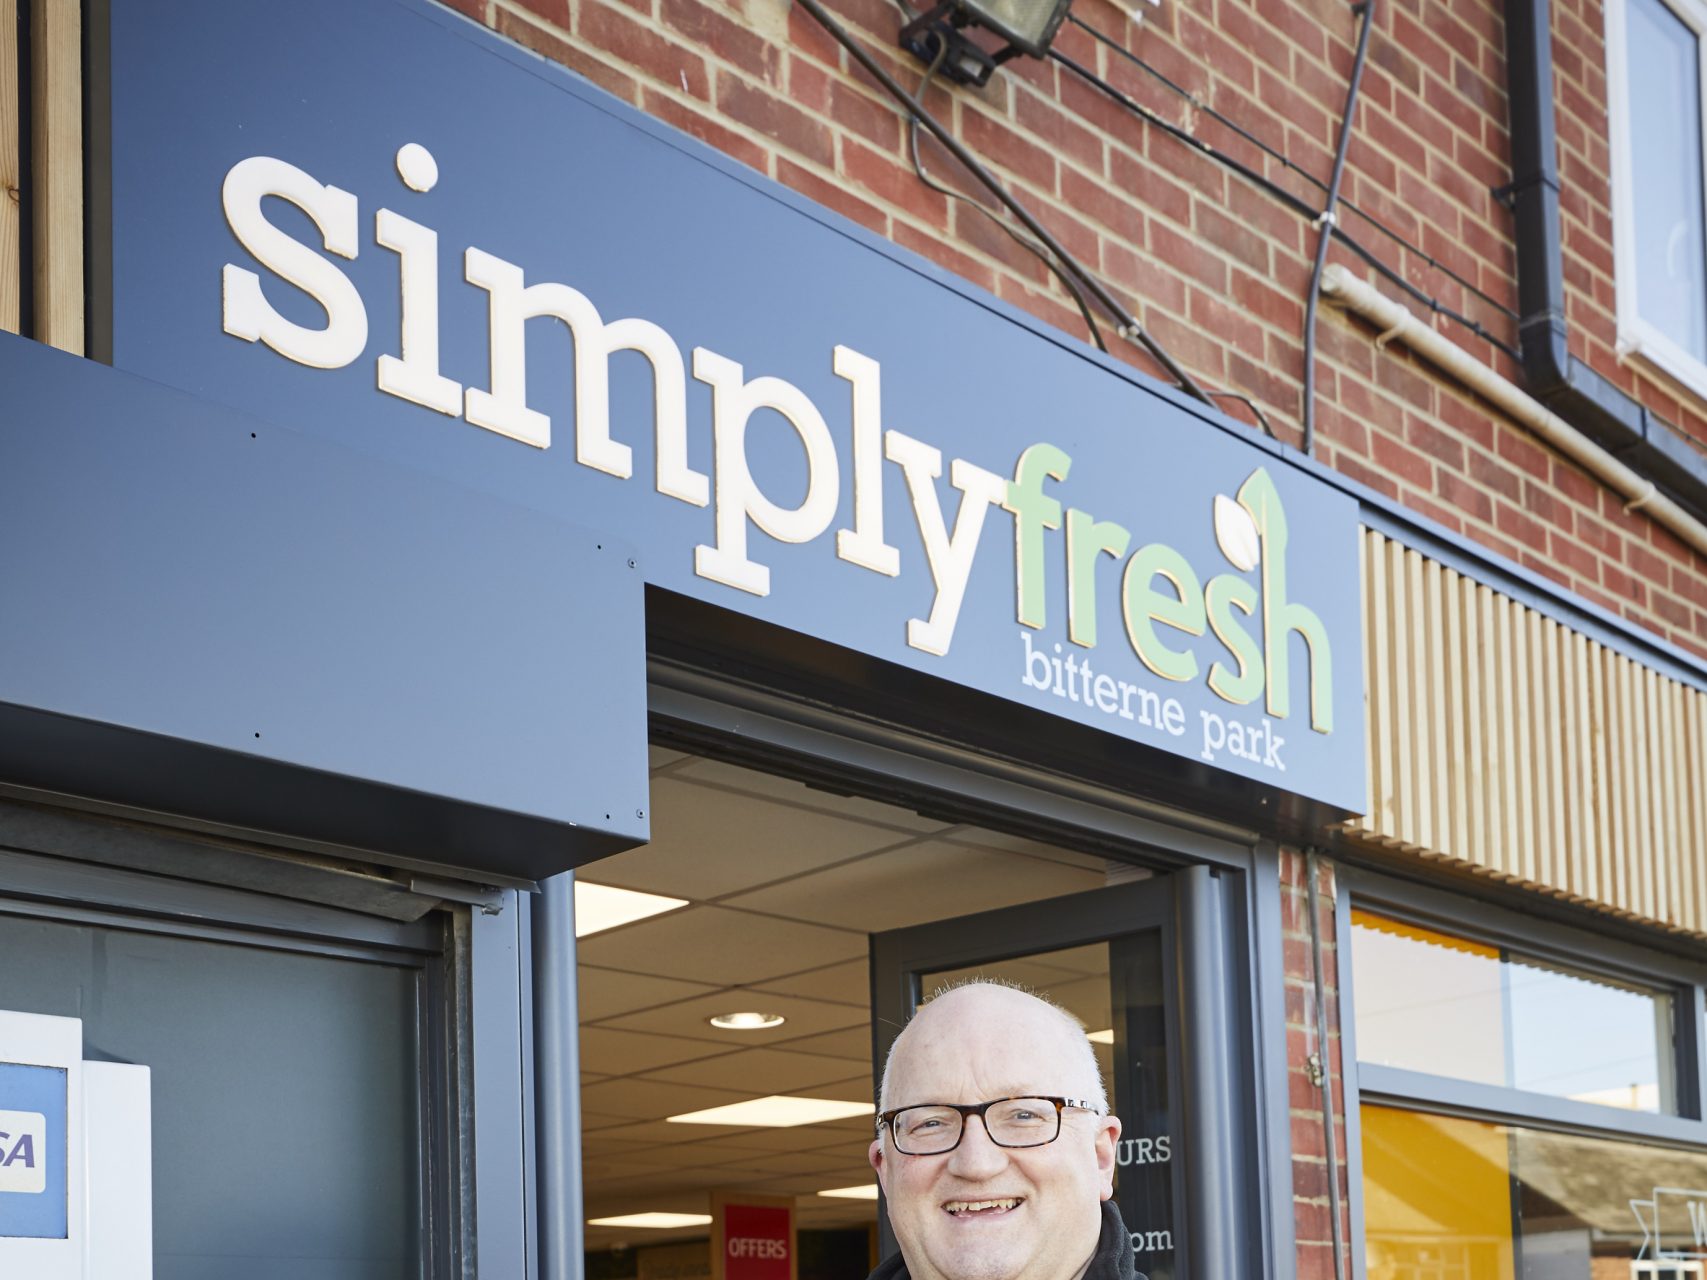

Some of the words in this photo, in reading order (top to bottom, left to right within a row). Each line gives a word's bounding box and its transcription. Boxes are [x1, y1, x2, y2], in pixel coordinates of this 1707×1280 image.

[1020, 631, 1187, 737] bitterne
[1200, 708, 1287, 772] park
[1116, 1135, 1171, 1167] URS
[728, 1237, 788, 1260] OFFERS
